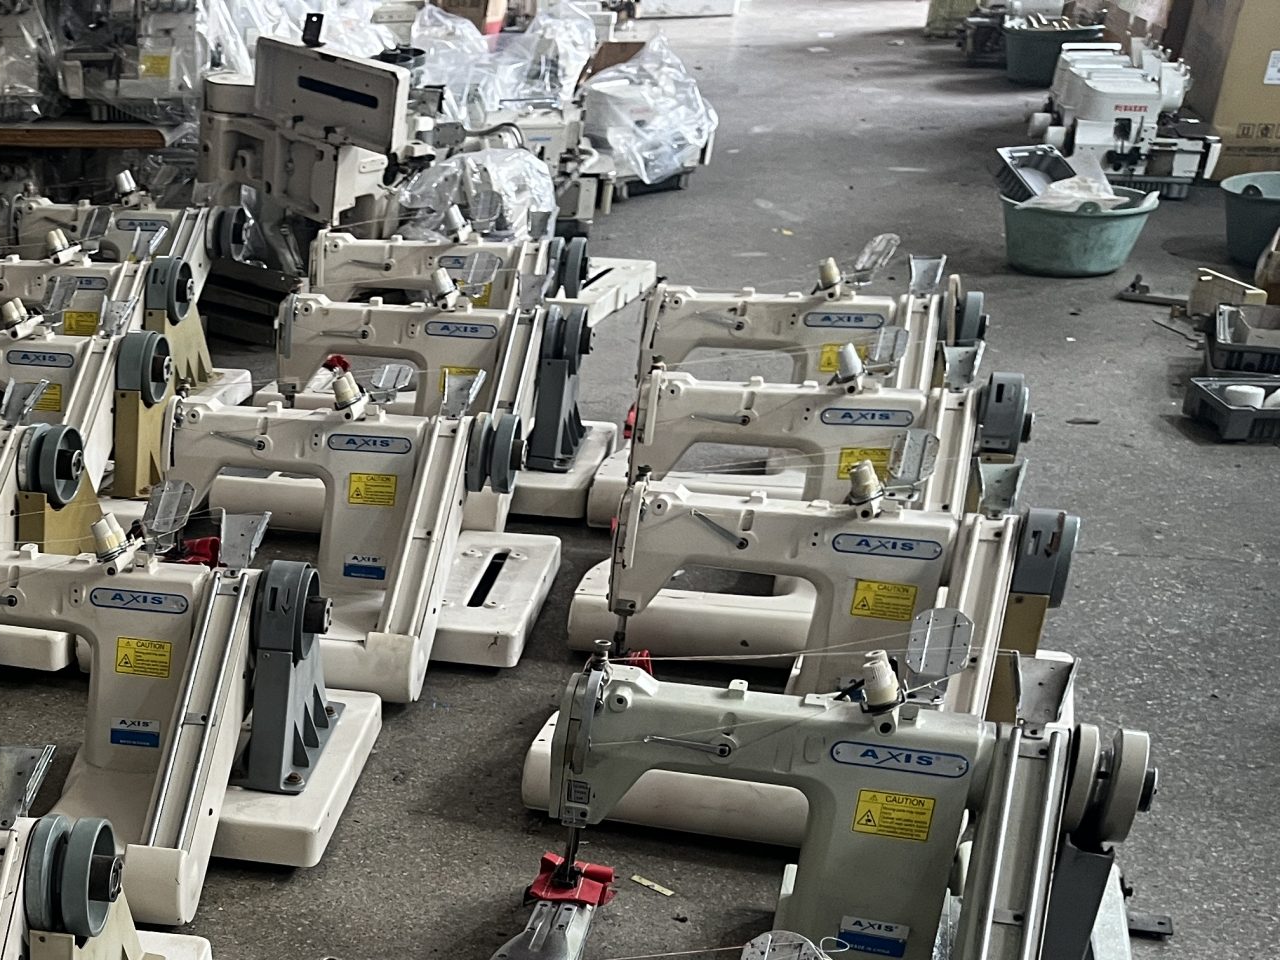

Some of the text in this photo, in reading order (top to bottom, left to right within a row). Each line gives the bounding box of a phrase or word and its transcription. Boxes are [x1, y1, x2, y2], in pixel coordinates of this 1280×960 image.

[821, 315, 864, 324] AXIS
[440, 324, 480, 334] AXIS
[20, 353, 57, 363] AXIS
[841, 411, 891, 423] AXIS
[345, 438, 390, 449] AXIS
[856, 538, 914, 552] AXIS
[877, 583, 909, 594] CAUTION
[110, 592, 163, 606] AXIS
[136, 641, 165, 650] CAUTION
[119, 719, 150, 728] AXIS
[860, 749, 933, 765] AXIS
[885, 795, 926, 807] CAUTION
[852, 920, 894, 932] AXIS
